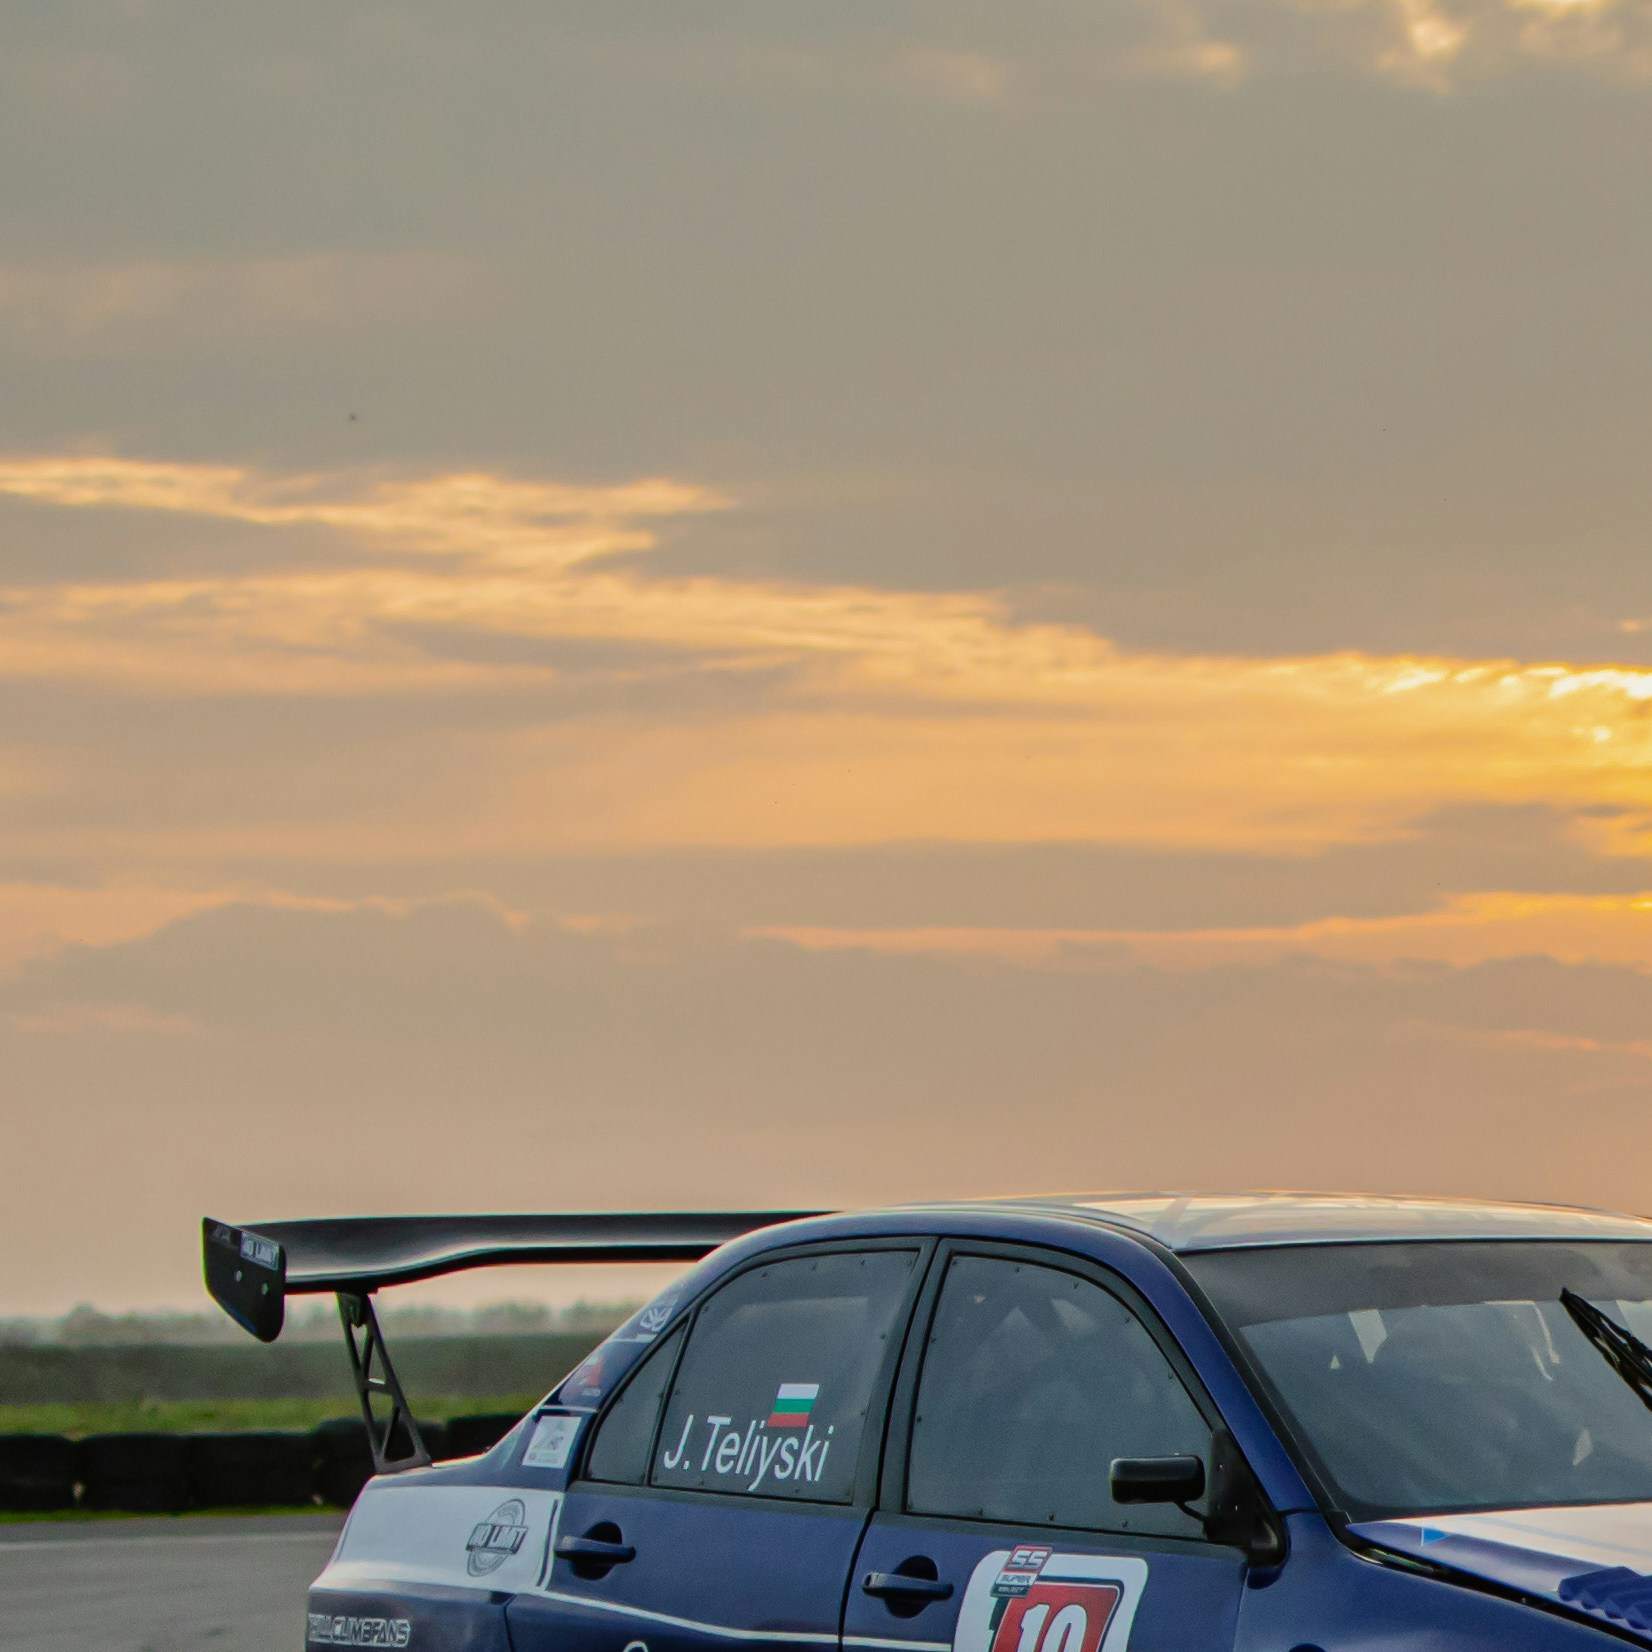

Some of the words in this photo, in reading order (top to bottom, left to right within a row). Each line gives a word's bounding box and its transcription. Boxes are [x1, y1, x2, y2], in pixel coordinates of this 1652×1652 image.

[664, 1414, 692, 1470] J.
[701, 1415, 835, 1492] Teliyski
[486, 1525, 528, 1552] LIMIT
